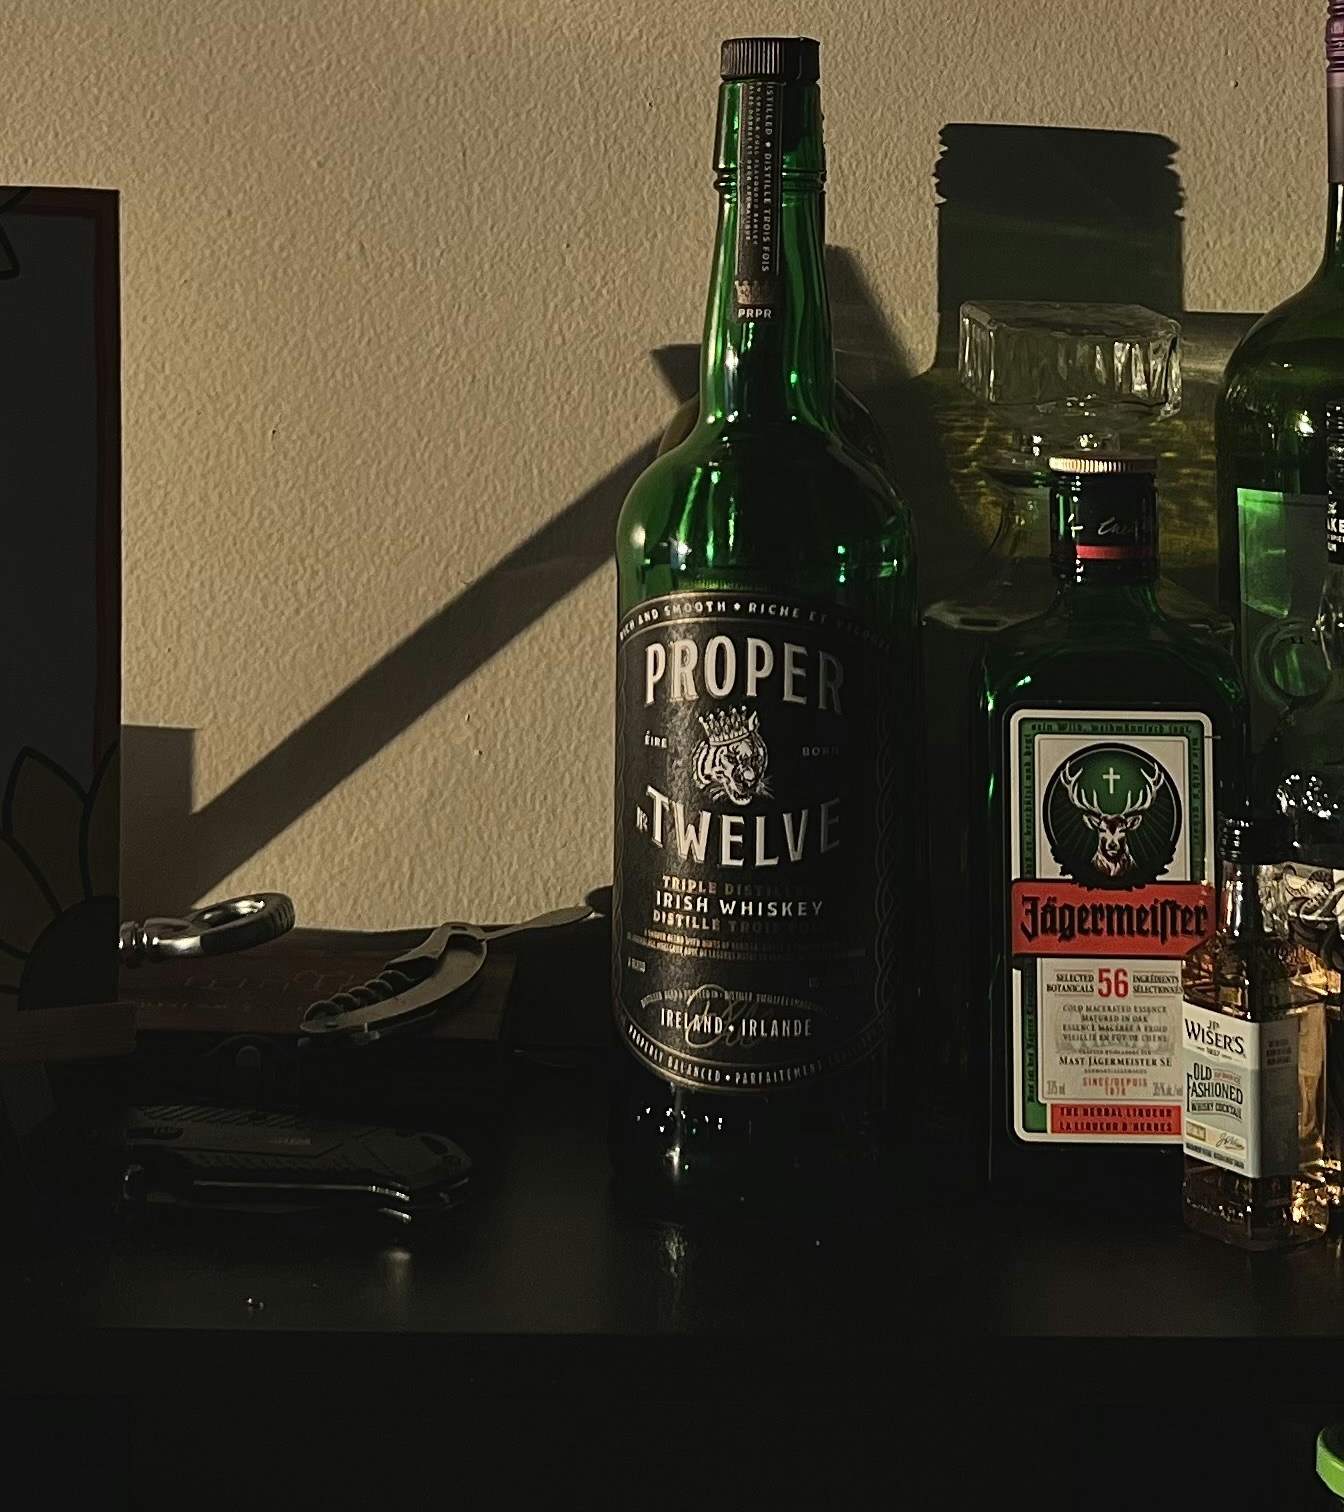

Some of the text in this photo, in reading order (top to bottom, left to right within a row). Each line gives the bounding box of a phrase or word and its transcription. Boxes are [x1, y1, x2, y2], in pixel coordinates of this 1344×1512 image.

[764, 84, 775, 136] ISTILLED
[762, 209, 772, 243] TROIS
[761, 246, 771, 272] FOIS
[737, 308, 773, 320] PRPR
[638, 607, 659, 626] AND
[664, 600, 727, 618] SMOOTH
[748, 601, 800, 620] RICHE
[644, 634, 845, 716] PROPER
[646, 784, 842, 869] TWELVE
[662, 874, 717, 895] TRIPLE
[656, 890, 824, 918] IRISH WHISKEY
[1047, 984, 1095, 993] BOTANICALS
[1056, 973, 1095, 983] SELECTED
[1097, 968, 1129, 998] 56
[1062, 1004, 1167, 1014] COLD MACERATED ESSENCE
[1081, 1015, 1120, 1023] MATURED
[1121, 1015, 1130, 1023] IN
[660, 1007, 813, 1038] IRELAND IRLANDE
[1062, 1023, 1096, 1032] ESSENCE
[667, 1054, 723, 1084] BALANCED
[1059, 1056, 1086, 1066] MAST
[1160, 1056, 1173, 1066] SE
[1193, 1062, 1212, 1081] OLD
[1186, 1073, 1244, 1112] FASHIONED
[1059, 1107, 1173, 1118] THE HERBAL LIQUEUR
[1190, 1101, 1242, 1120] WHISKY COCKTAIL
[1059, 1120, 1072, 1131] LA
[1074, 1121, 1119, 1132] LIQUEUR
